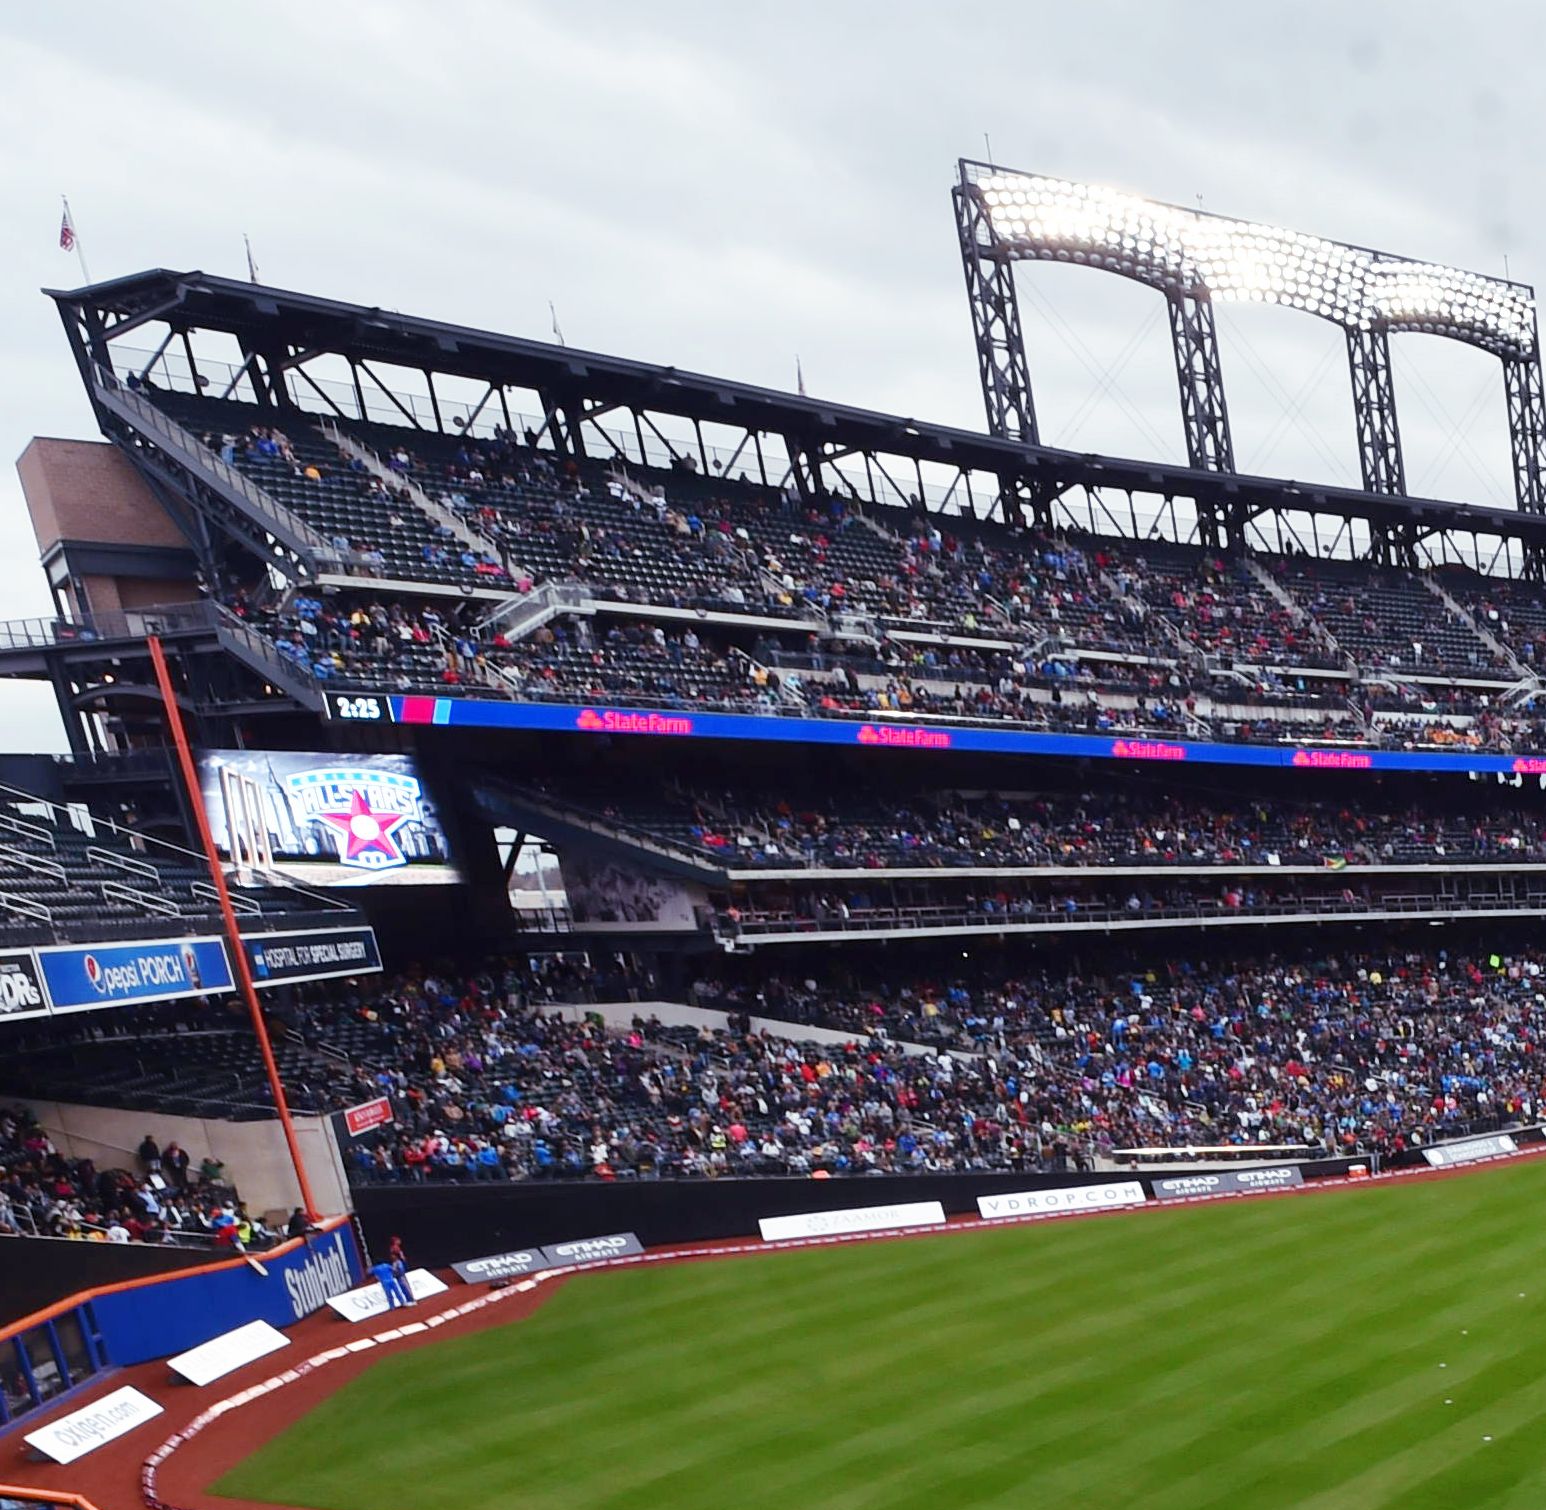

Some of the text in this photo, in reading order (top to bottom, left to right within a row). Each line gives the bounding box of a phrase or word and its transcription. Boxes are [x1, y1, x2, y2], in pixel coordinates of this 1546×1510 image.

[337, 698, 381, 719] 2:25
[264, 951, 298, 968] HOSPITAL
[298, 950, 310, 965] FOR
[310, 947, 338, 964] SPECIAL
[339, 942, 366, 961] SURGERY
[103, 955, 182, 996] pepsi PORCH
[1162, 1176, 1220, 1191] ETIHAD
[1237, 1168, 1292, 1183] ETIHAD
[988, 1188, 1138, 1211] VDROP.COM
[556, 1237, 628, 1256] ETIHAD
[466, 1252, 533, 1273] ETIHAD
[284, 1231, 352, 1320] StubHub!
